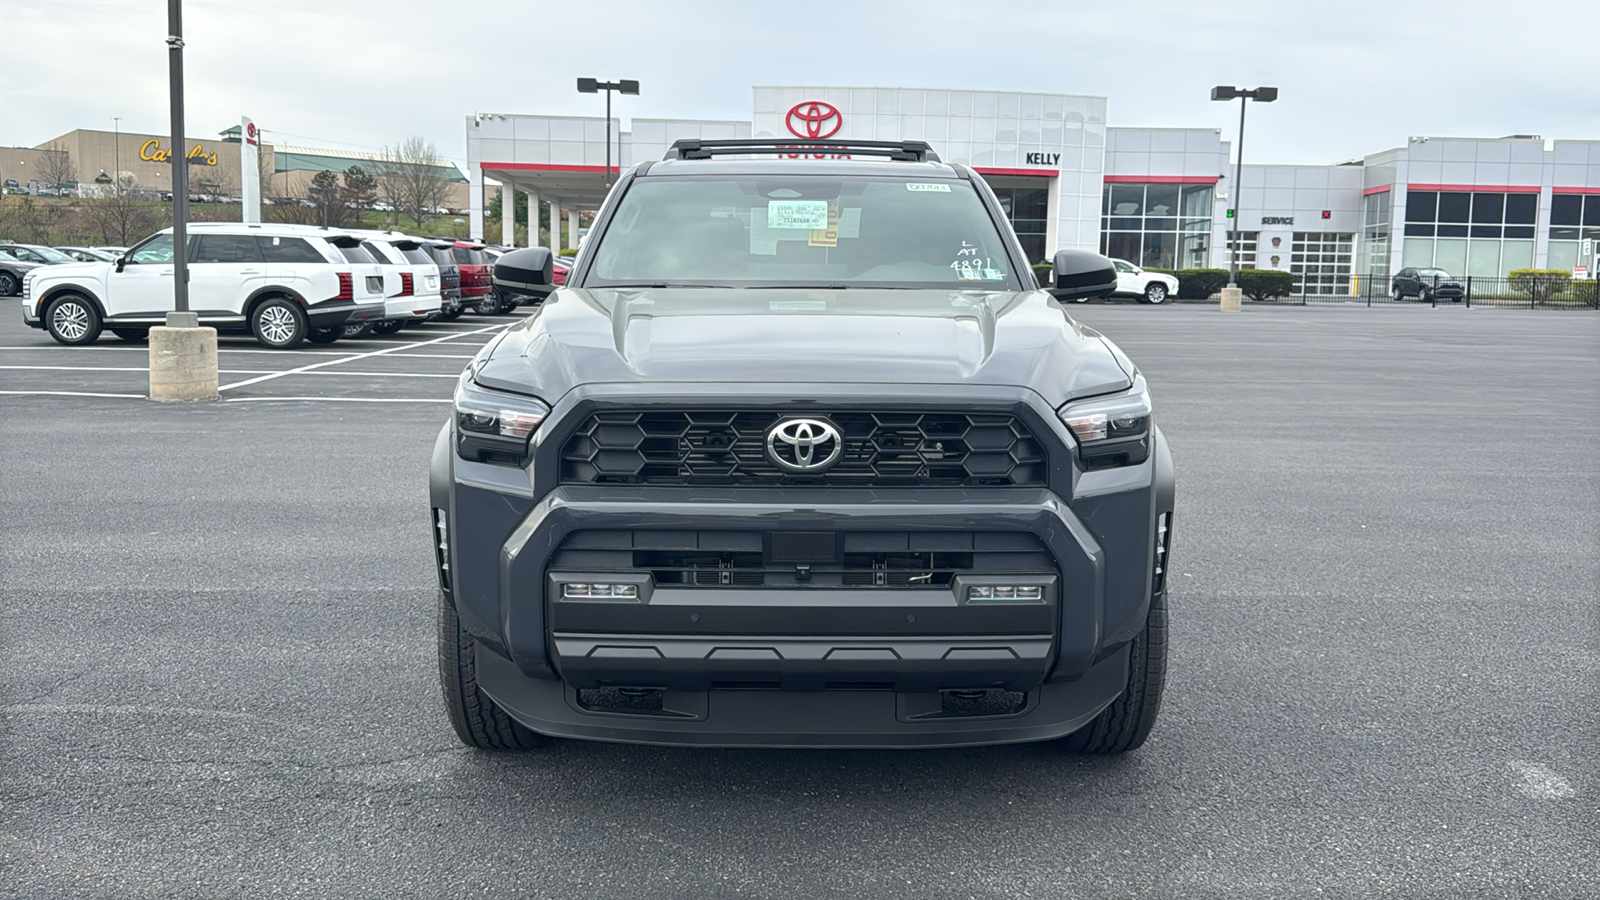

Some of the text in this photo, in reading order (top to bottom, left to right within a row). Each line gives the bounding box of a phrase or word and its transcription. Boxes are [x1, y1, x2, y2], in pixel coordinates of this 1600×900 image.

[1026, 152, 1060, 166] KELLY
[1261, 216, 1294, 225] SERVICE
[957, 248, 978, 256] AT
[950, 257, 991, 272] 4891
